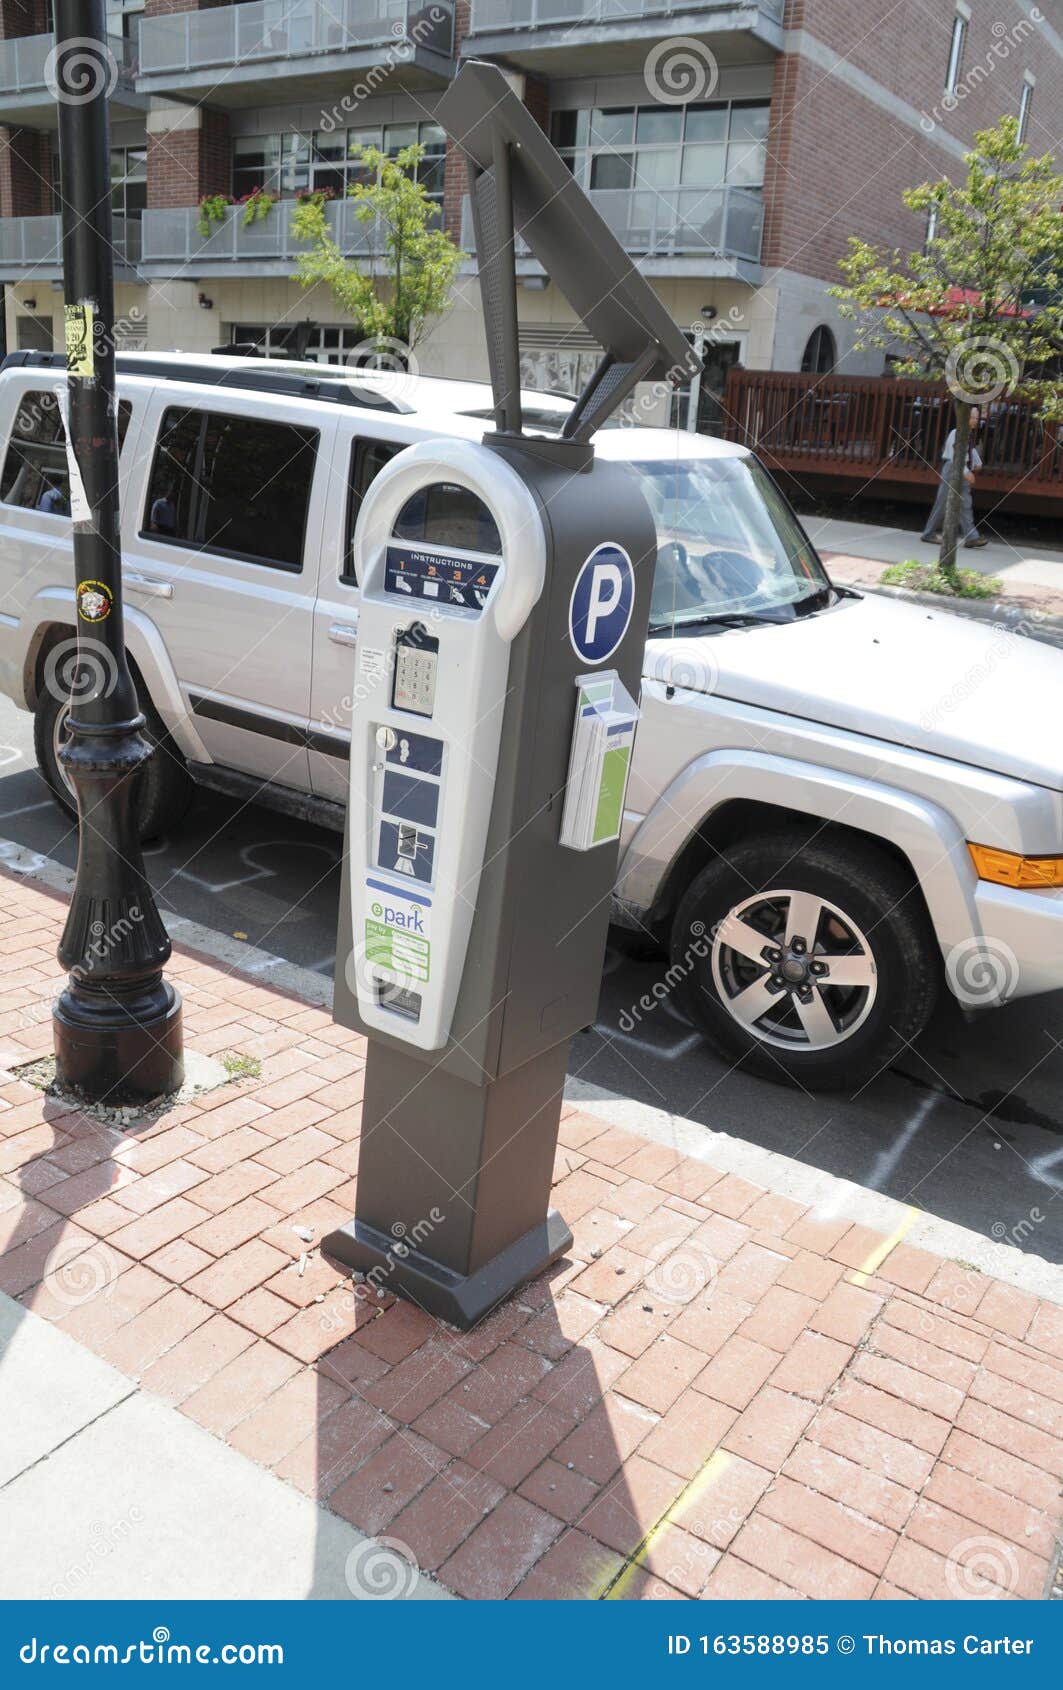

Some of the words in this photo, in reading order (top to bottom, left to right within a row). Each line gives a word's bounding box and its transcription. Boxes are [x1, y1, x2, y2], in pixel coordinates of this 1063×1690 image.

[400, 560, 406, 571] 1
[428, 565, 437, 577] 2
[453, 570, 462, 581] 3
[477, 575, 487, 586] 4
[410, 553, 473, 570] INSTRUCTIONS
[584, 563, 623, 644] P
